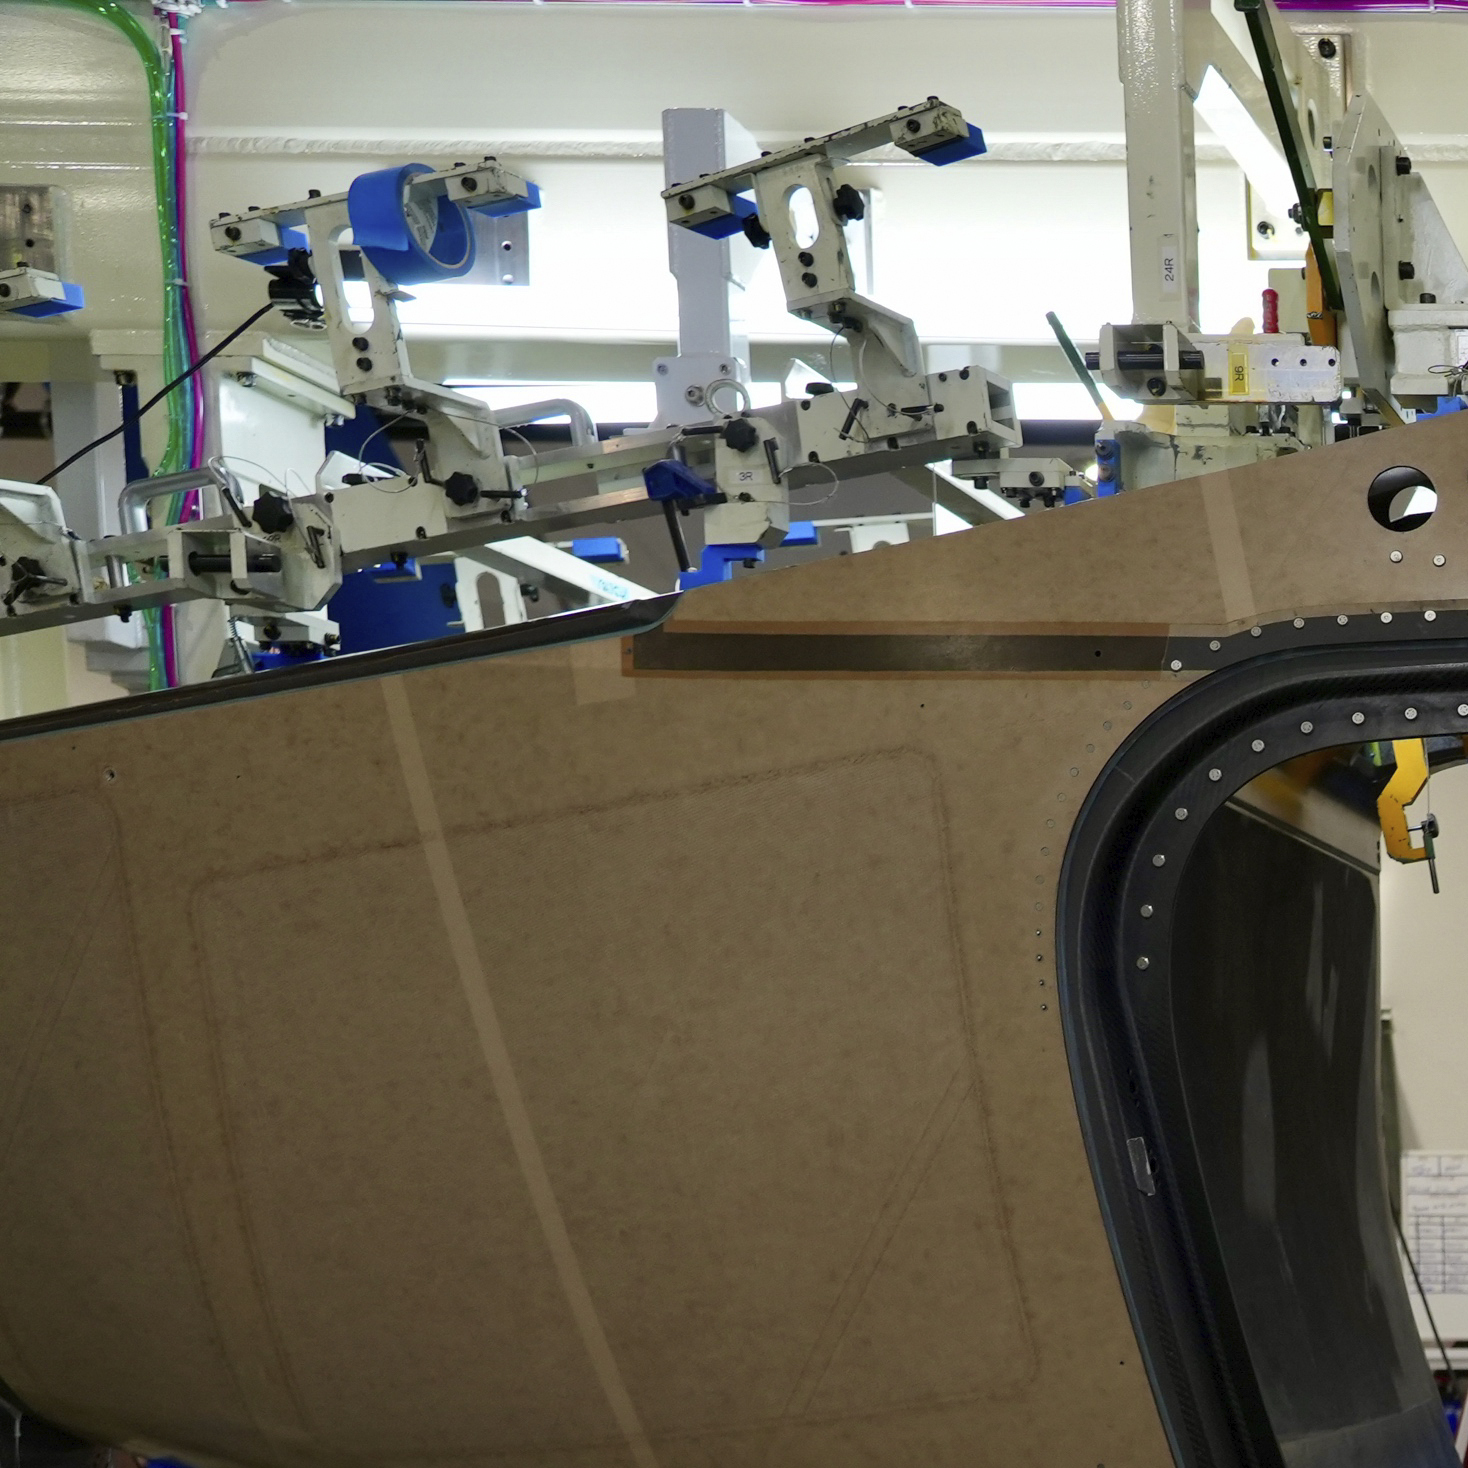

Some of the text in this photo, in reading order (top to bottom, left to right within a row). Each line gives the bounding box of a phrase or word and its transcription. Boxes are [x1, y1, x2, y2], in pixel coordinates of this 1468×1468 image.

[1163, 257, 1174, 282] 24R
[1234, 365, 1245, 382] 9R
[739, 471, 753, 481] 3R
